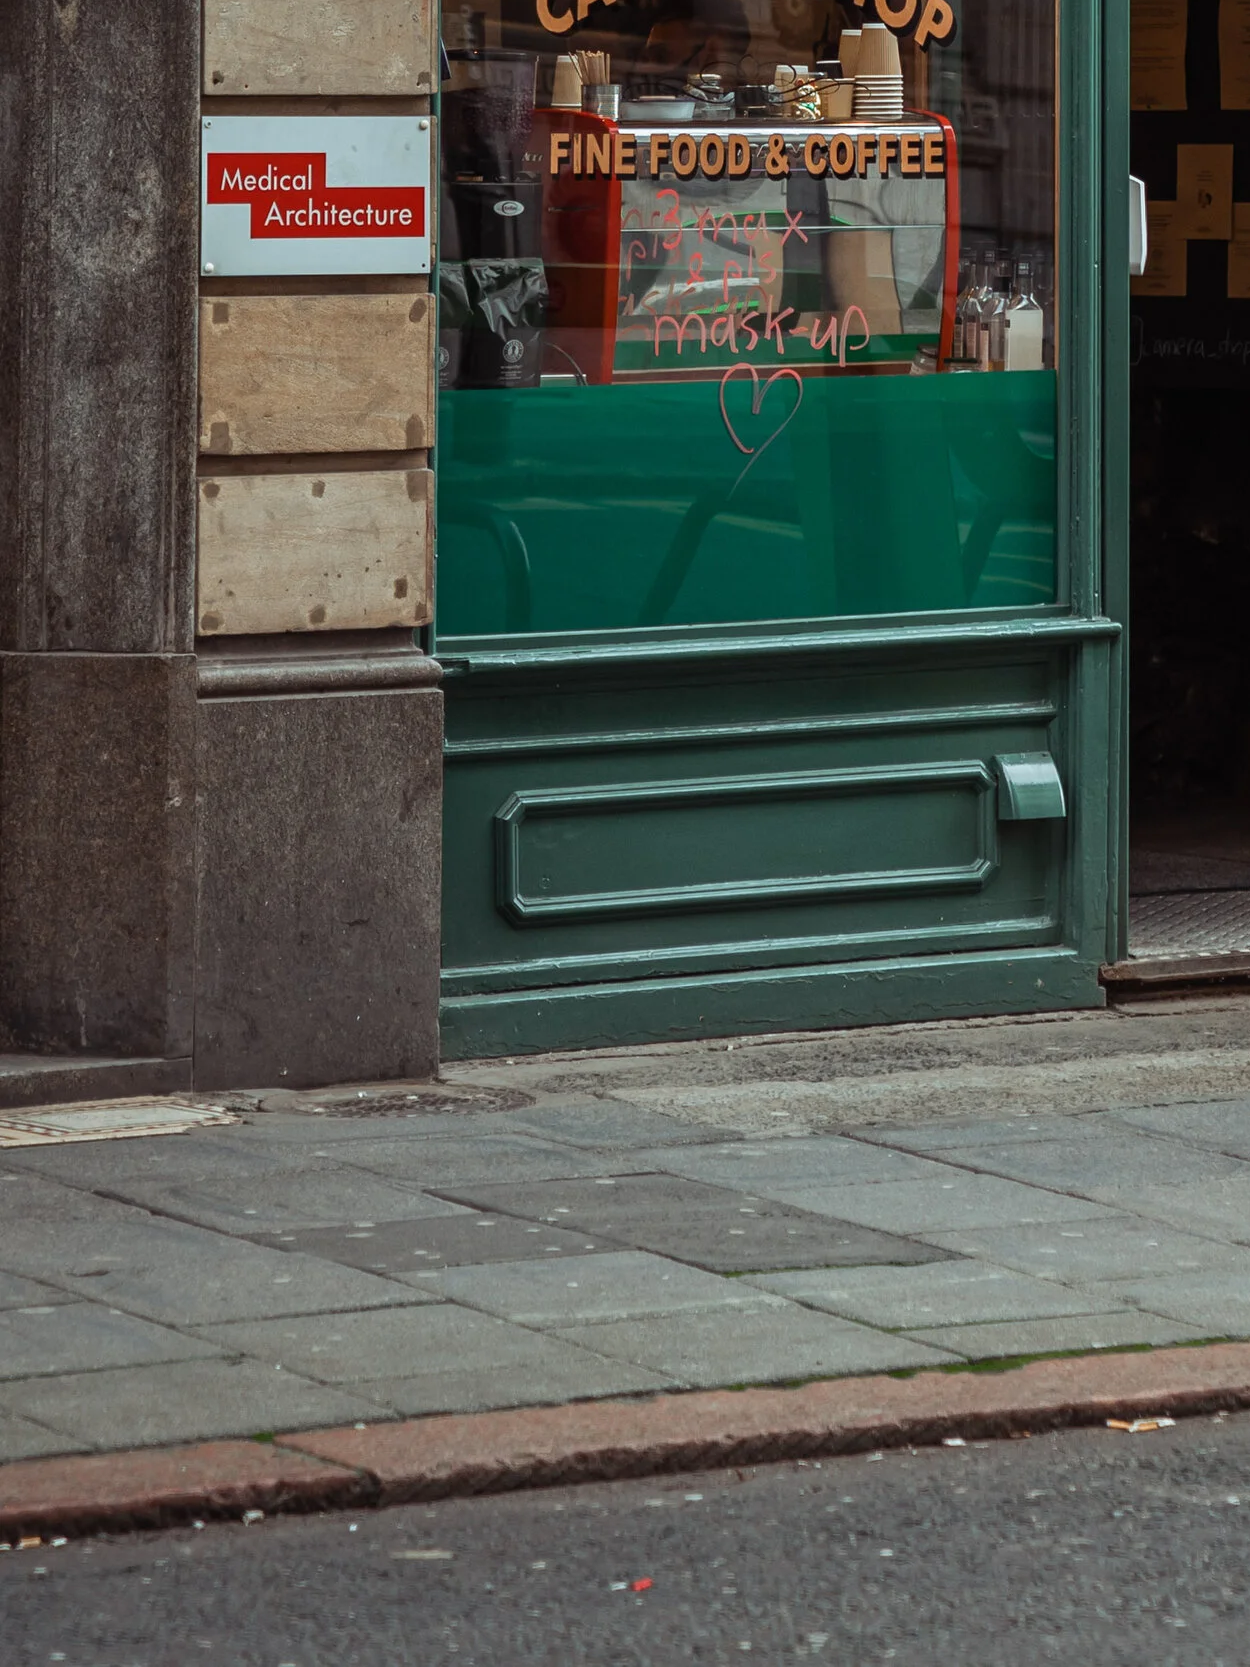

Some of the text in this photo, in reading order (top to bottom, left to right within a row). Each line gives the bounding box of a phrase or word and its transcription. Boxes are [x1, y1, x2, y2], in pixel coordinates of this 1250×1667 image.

[550, 133, 945, 176] FINE FOOD & COFFEE
[220, 164, 313, 191] Medical
[264, 198, 413, 226] Architecture
[656, 189, 808, 250] 3 max
[654, 294, 871, 368] mask-up
